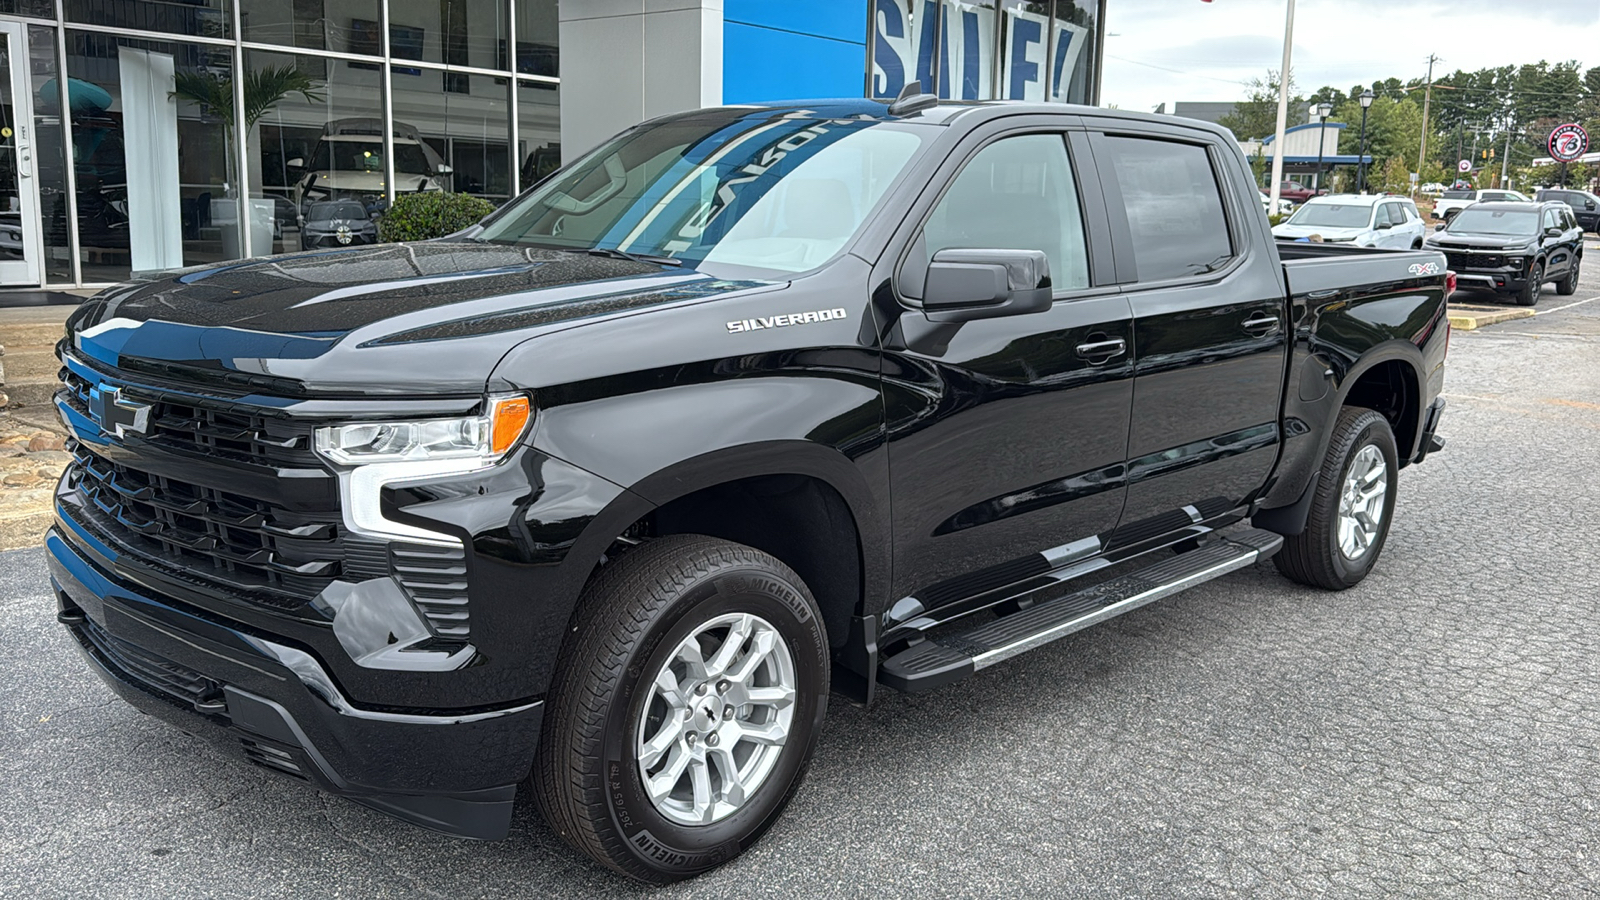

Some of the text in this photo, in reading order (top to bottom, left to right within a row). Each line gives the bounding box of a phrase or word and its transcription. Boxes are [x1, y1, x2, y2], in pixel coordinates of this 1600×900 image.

[726, 307, 847, 334] SILVERADO
[749, 578, 824, 667] MICHELIN PRIMACY
[614, 793, 633, 828] 265/65
[635, 834, 702, 867] MICHELIN
